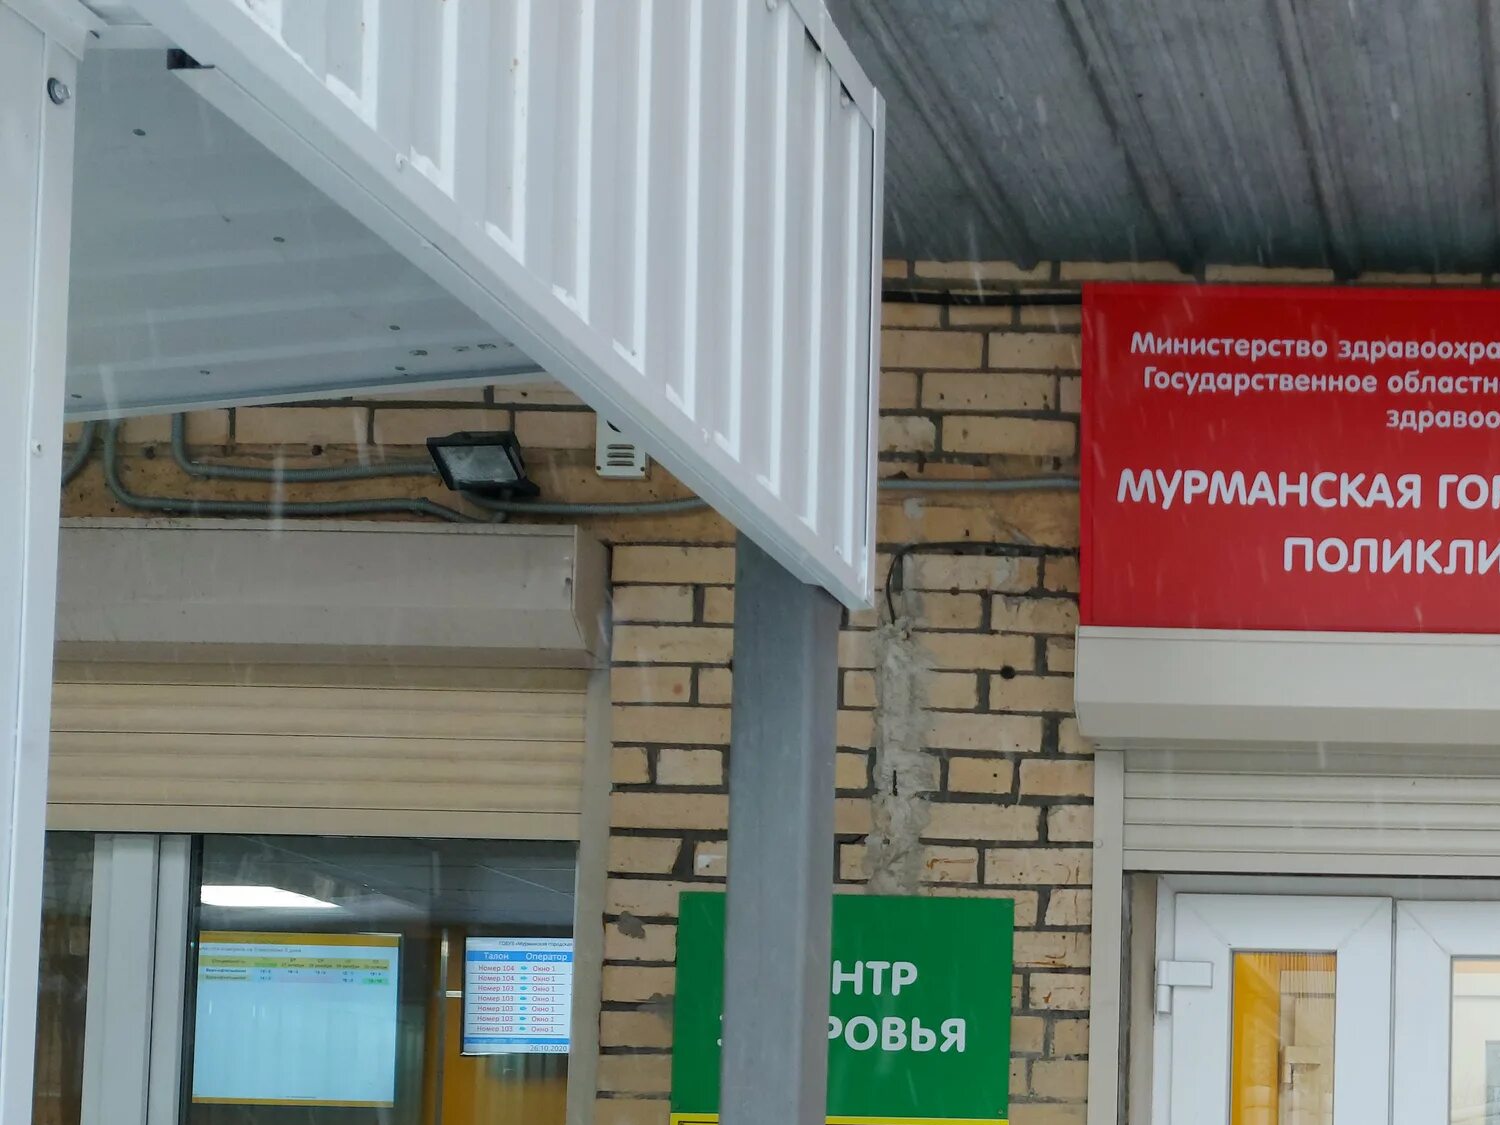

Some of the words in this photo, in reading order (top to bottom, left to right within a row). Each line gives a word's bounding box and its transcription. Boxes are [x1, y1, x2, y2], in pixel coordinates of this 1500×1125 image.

[1131, 331, 1328, 361] Министерство
[1144, 367, 1377, 396] Государственное
[1117, 469, 1420, 511] МУРМАНСКАЯ
[484, 952, 509, 960] Талон
[526, 953, 567, 961] Оператор
[832, 960, 918, 996] НТР
